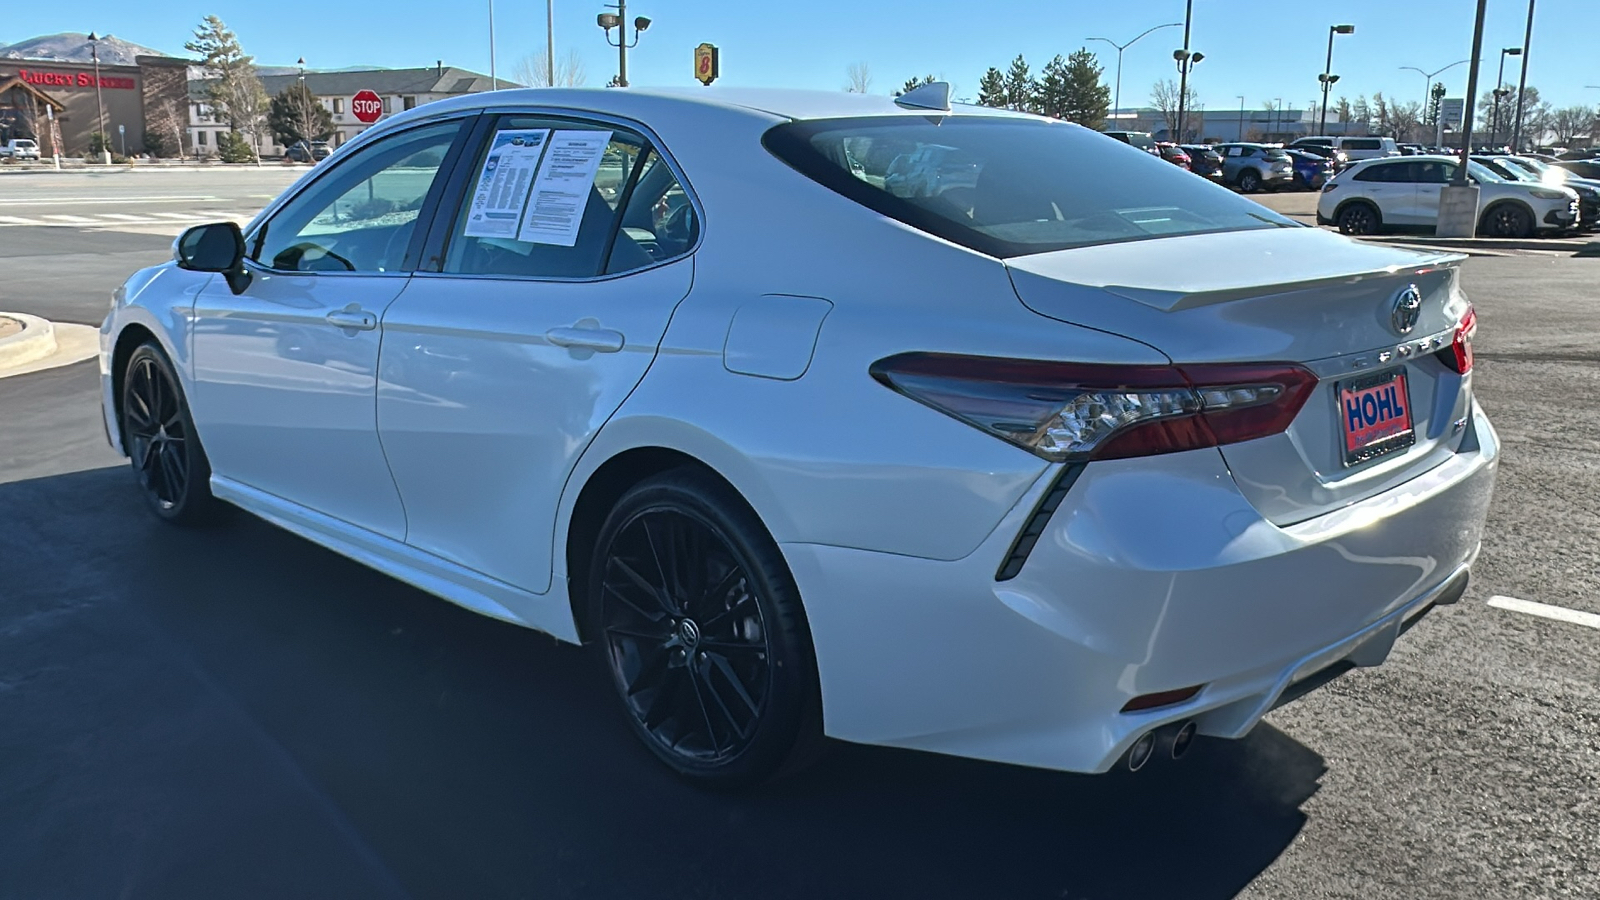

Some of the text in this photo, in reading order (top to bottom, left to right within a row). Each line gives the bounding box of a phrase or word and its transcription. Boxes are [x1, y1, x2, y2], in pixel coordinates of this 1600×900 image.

[700, 56, 710, 74] 8
[19, 69, 75, 86] LUCKY
[354, 100, 381, 114] STOP
[1346, 385, 1404, 433] HOHL
